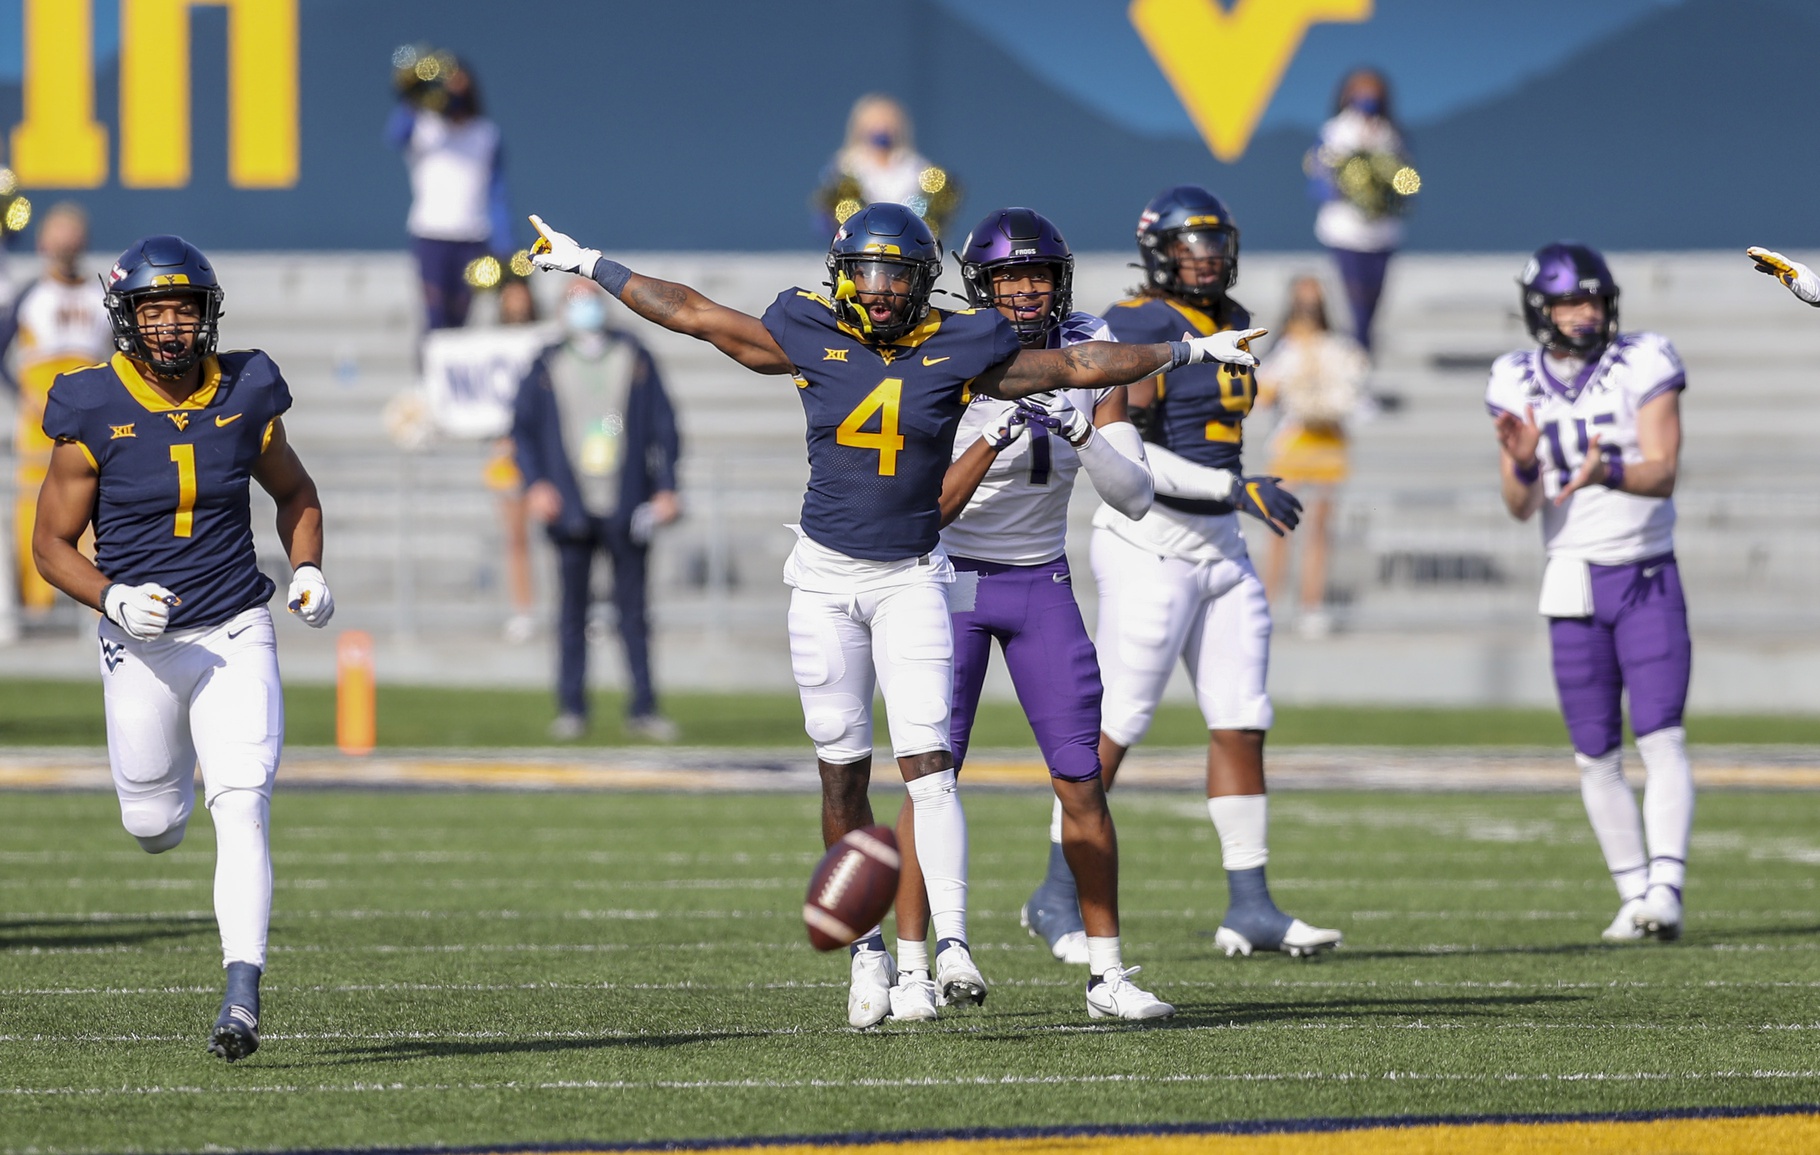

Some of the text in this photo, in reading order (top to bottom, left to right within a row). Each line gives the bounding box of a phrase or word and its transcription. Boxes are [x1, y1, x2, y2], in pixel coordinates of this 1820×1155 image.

[1014, 248, 1037, 256] FROGS
[823, 347, 849, 362] XII
[836, 378, 904, 476] 4
[1205, 363, 1252, 444] 9
[109, 423, 137, 440] XII
[169, 443, 197, 538] 1
